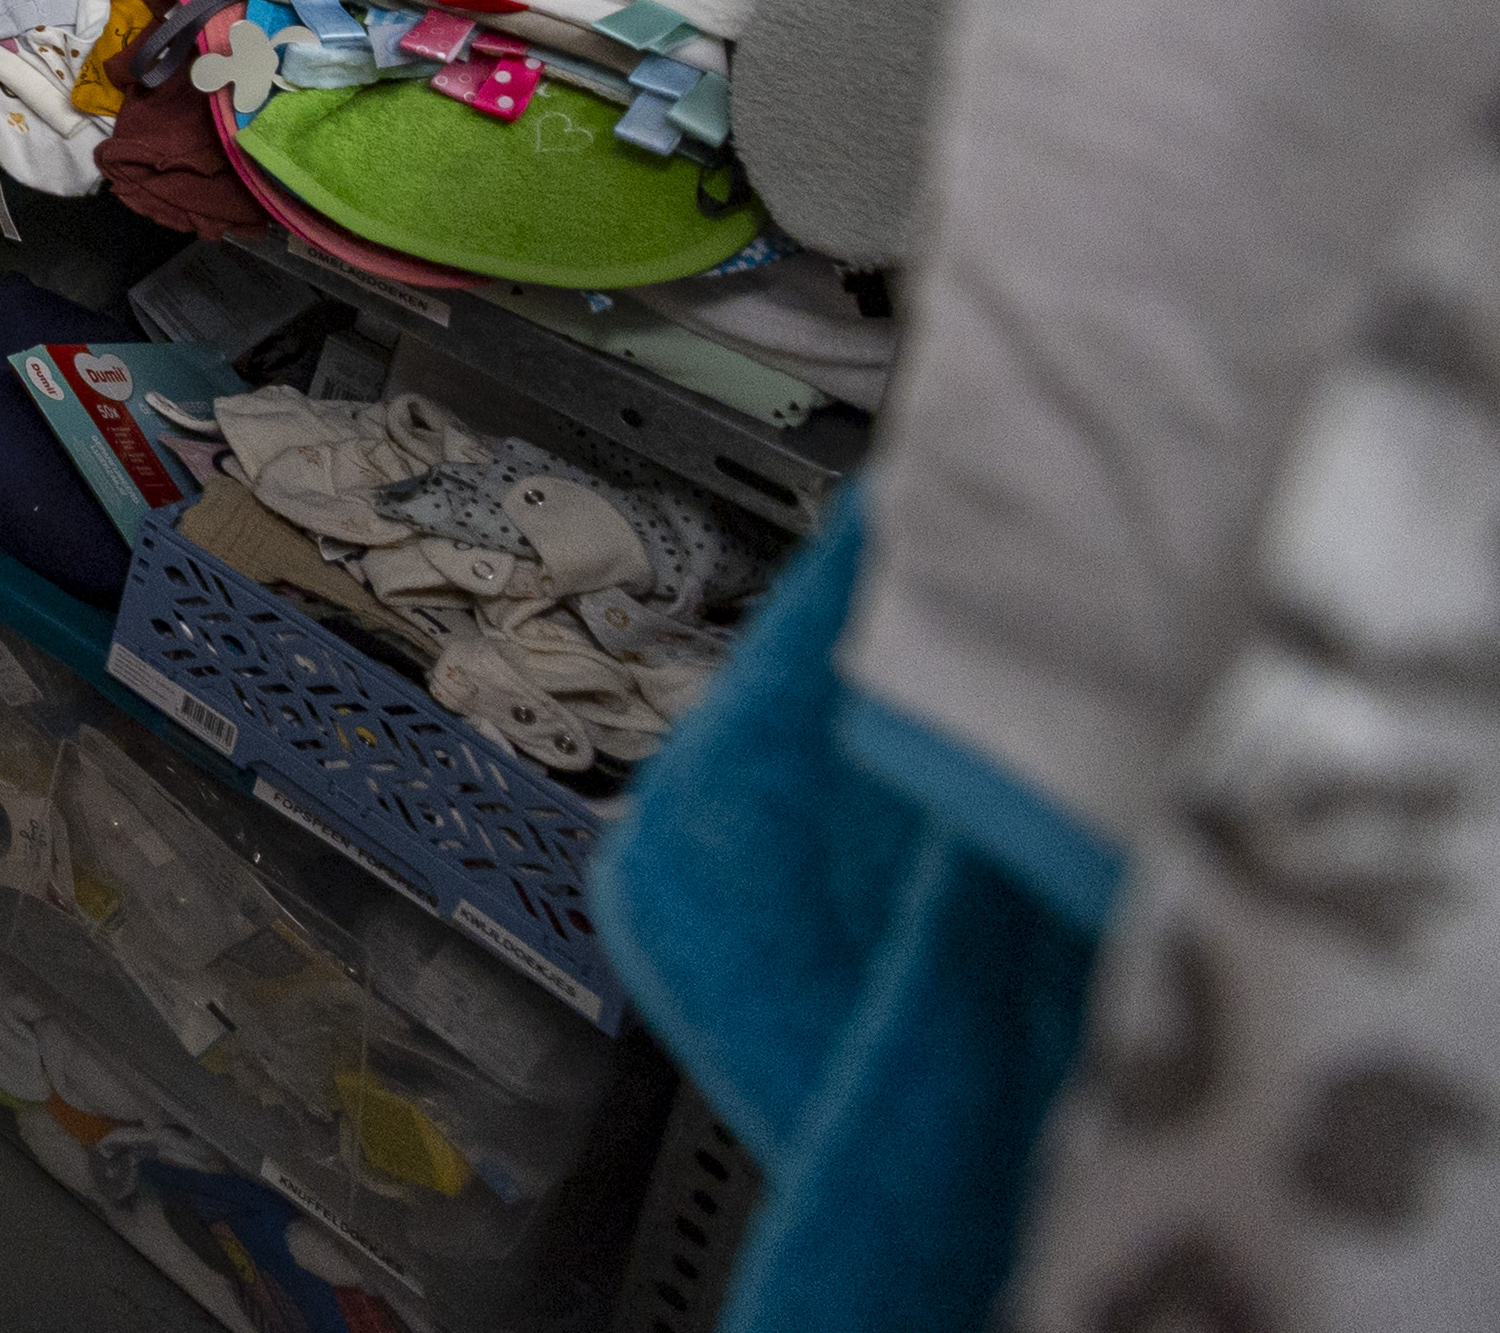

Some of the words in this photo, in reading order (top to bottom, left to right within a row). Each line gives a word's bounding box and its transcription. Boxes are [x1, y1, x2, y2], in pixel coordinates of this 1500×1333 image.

[30, 362, 58, 396] Dumil
[85, 366, 129, 384] Dumil
[97, 404, 121, 420] 50x
